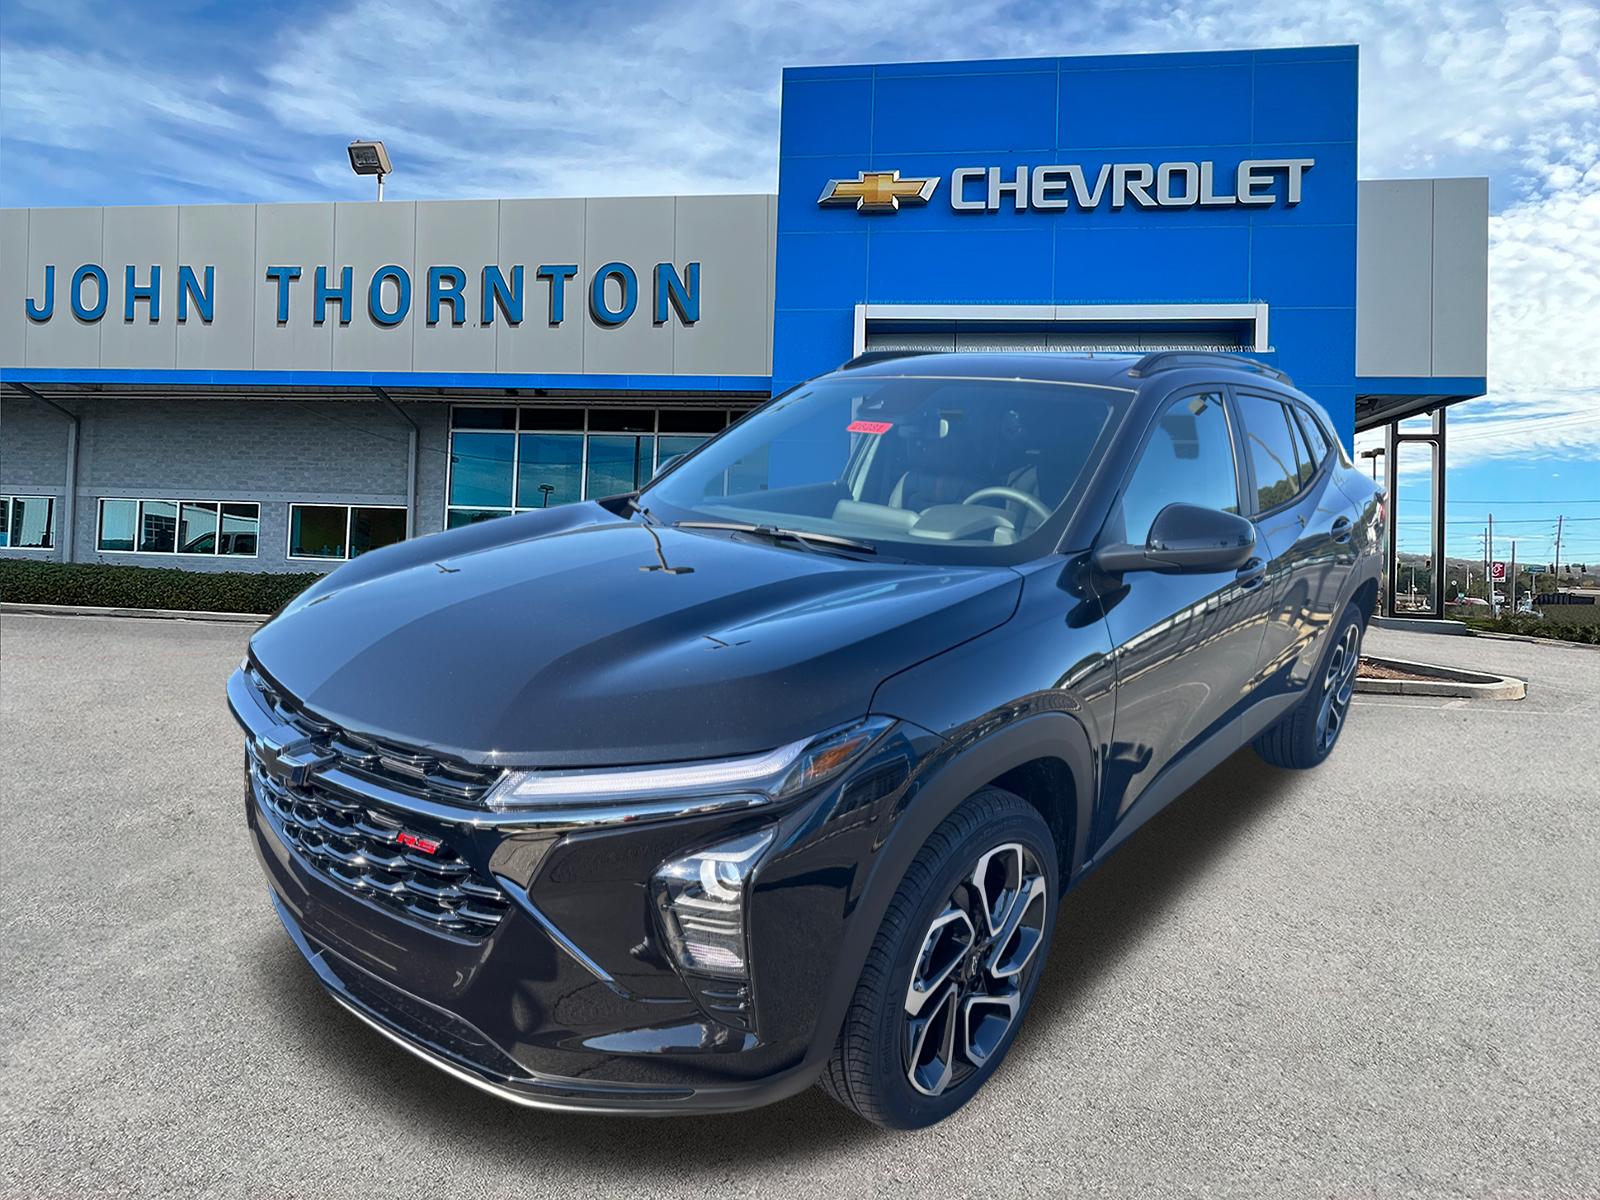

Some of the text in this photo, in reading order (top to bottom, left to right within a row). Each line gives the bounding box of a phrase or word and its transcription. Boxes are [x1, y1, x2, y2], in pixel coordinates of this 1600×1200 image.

[951, 158, 1315, 209] CHEVROLET
[26, 261, 702, 327] JOHN THORNTON
[396, 832, 439, 855] RS
